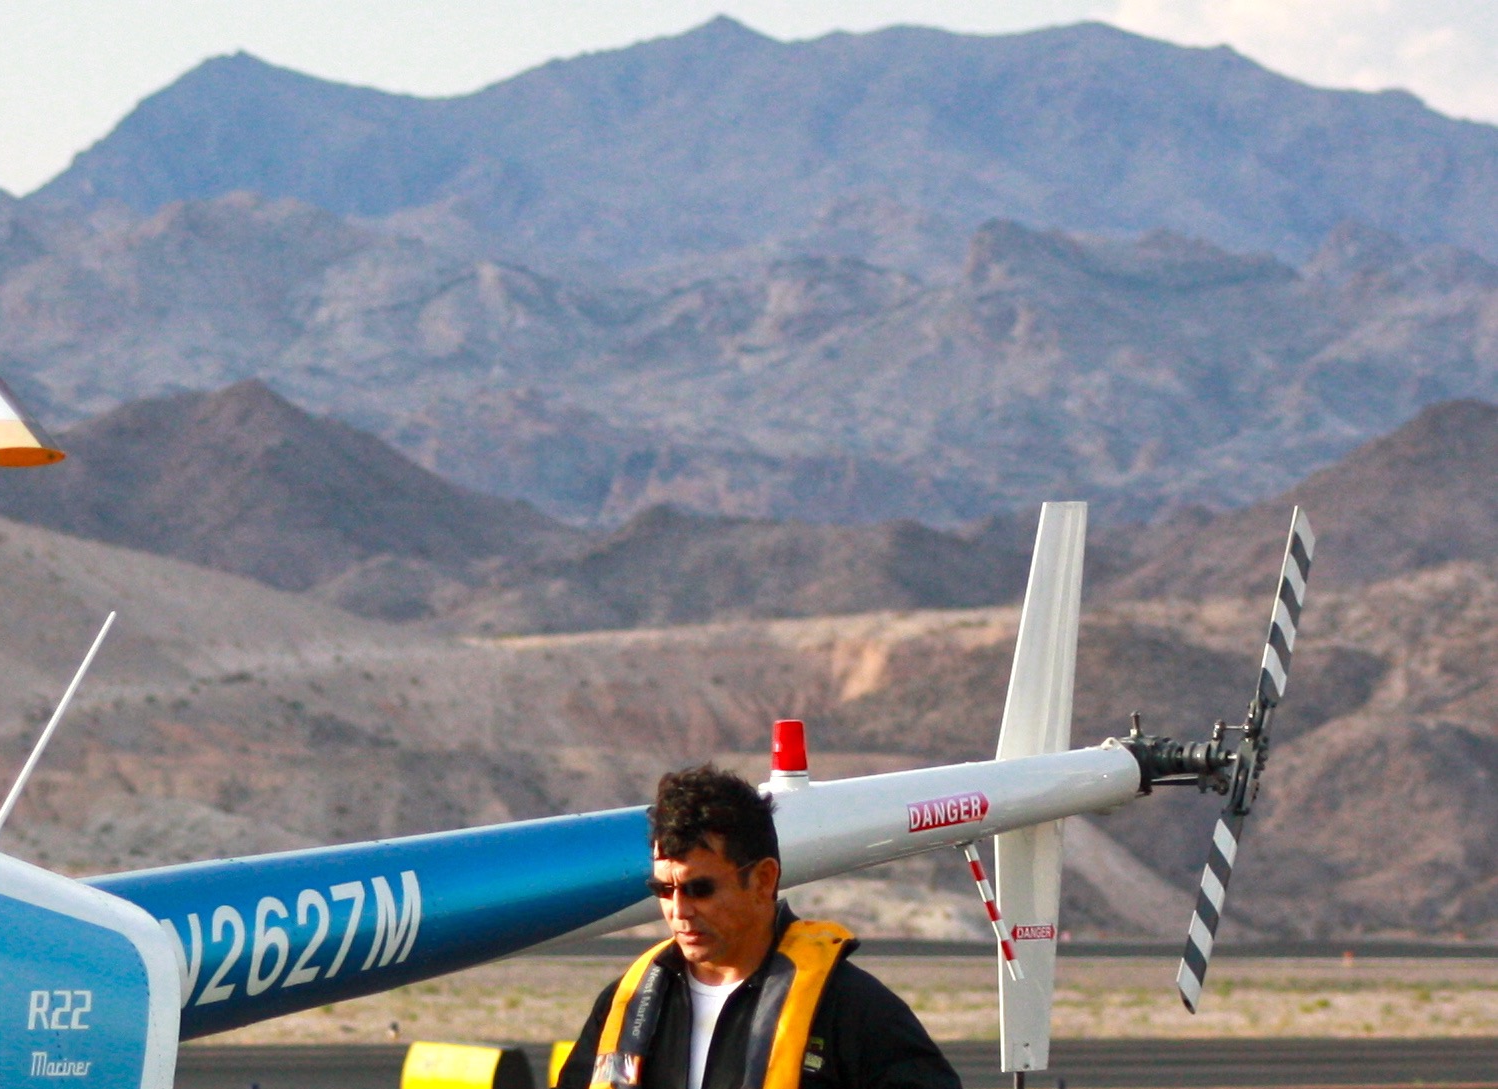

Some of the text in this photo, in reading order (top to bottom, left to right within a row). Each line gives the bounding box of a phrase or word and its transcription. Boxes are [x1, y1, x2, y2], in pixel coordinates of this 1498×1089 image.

[908, 795, 983, 830] DANGER
[159, 869, 422, 1010] N2627M
[1016, 926, 1052, 938] DANGER
[27, 990, 92, 1030] R22
[30, 1051, 92, 1076] Mariner
